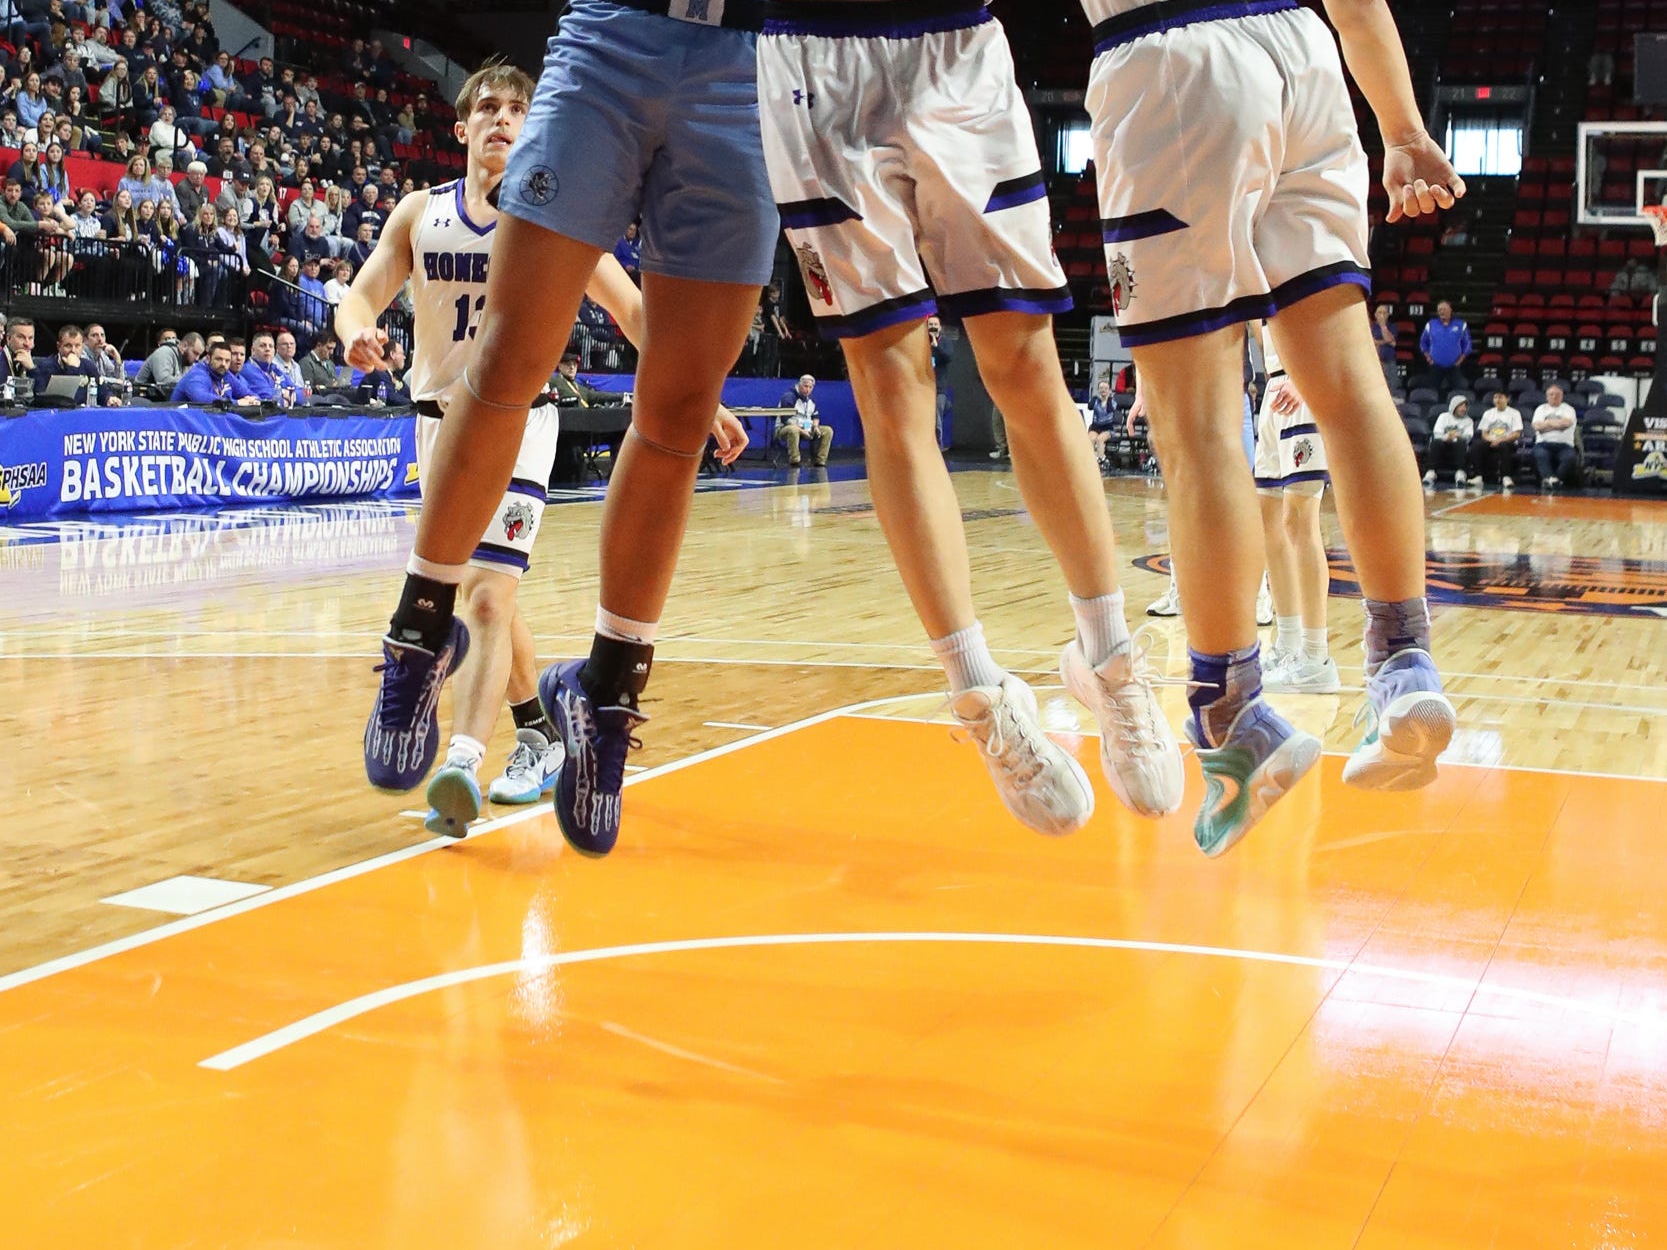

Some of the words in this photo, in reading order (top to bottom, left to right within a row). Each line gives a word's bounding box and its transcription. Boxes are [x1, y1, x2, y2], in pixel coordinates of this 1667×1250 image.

[423, 252, 491, 283] HONE
[64, 432, 96, 456] NEW
[99, 430, 136, 452] YORK
[138, 430, 176, 451] STATE
[178, 432, 222, 456] PUBLIC
[222, 437, 247, 458] HIGH
[248, 438, 293, 459] SCHOOL
[295, 437, 342, 459] ATHLETIC
[343, 436, 400, 458] ASSOCIATION
[60, 455, 231, 502] BASKETBALL
[232, 457, 398, 497] CHAMPIONSHIPS
